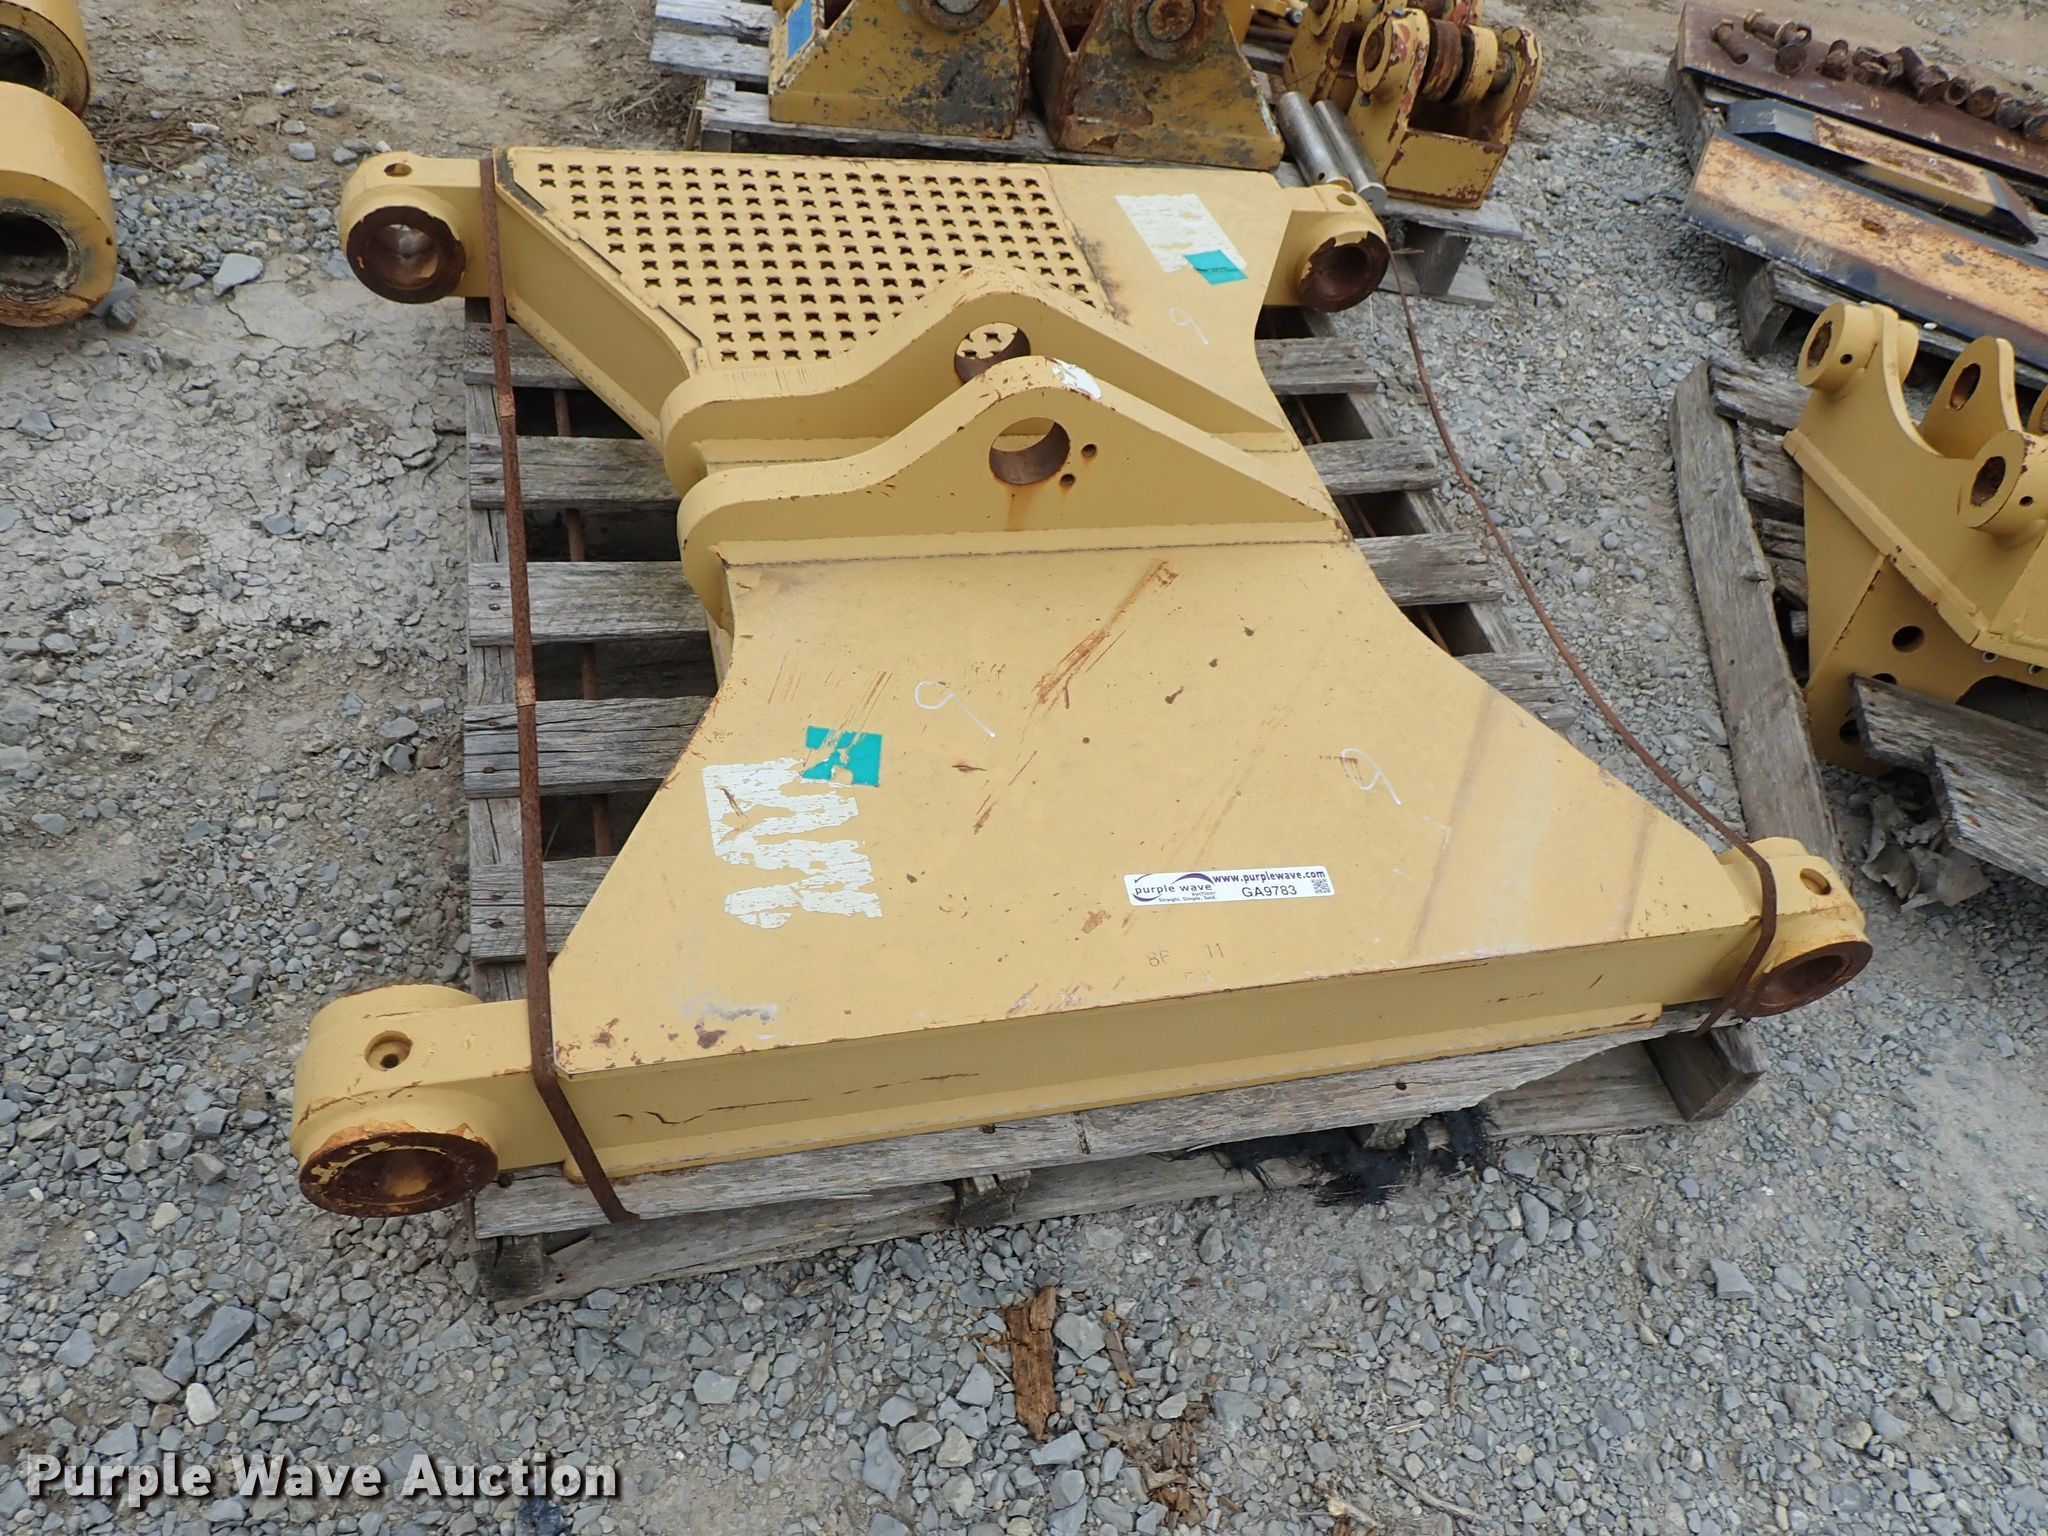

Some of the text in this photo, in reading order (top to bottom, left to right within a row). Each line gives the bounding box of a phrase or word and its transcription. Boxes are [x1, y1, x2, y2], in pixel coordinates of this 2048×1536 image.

[1212, 870, 1325, 884] www.purplewave.com
[1134, 884, 1212, 896] purple wave
[1241, 884, 1298, 898] GA9783
